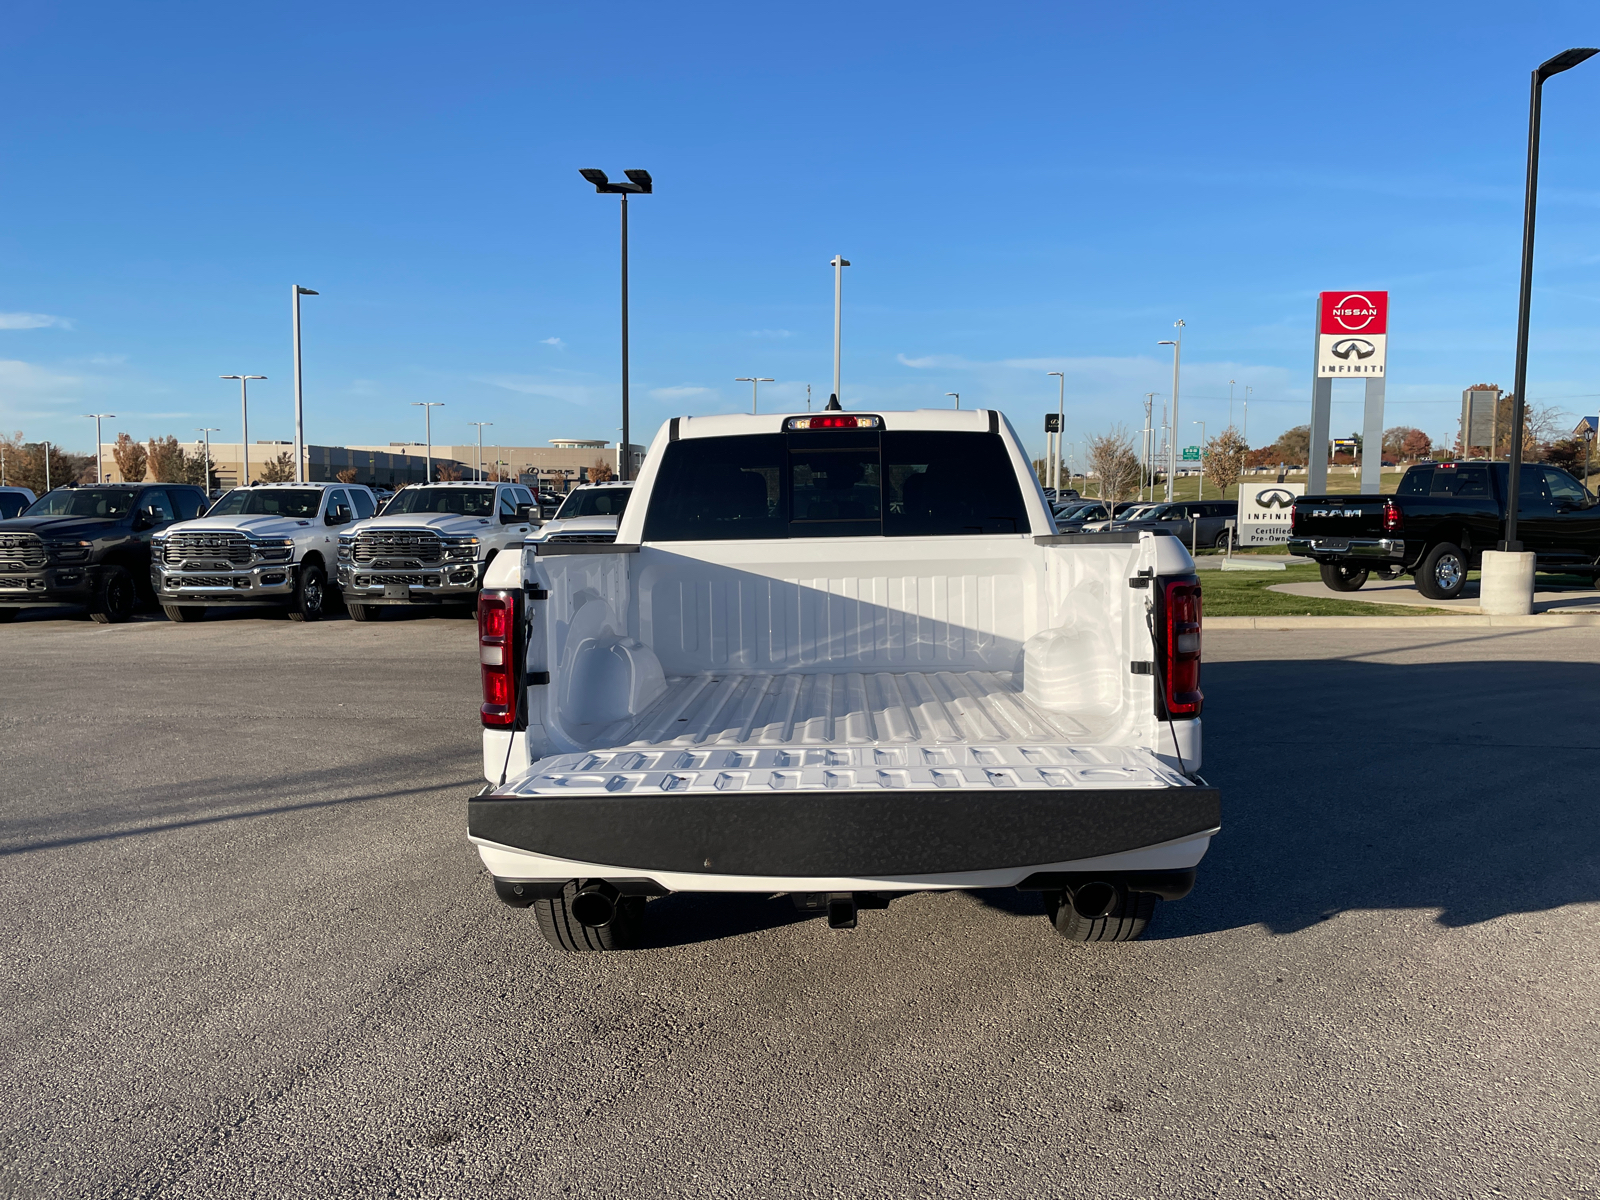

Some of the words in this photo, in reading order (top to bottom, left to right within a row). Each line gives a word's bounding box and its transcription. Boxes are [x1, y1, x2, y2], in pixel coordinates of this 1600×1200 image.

[1322, 365, 1383, 373] INFINITI
[1312, 509, 1362, 518] RAM
[1255, 527, 1292, 535] Certified
